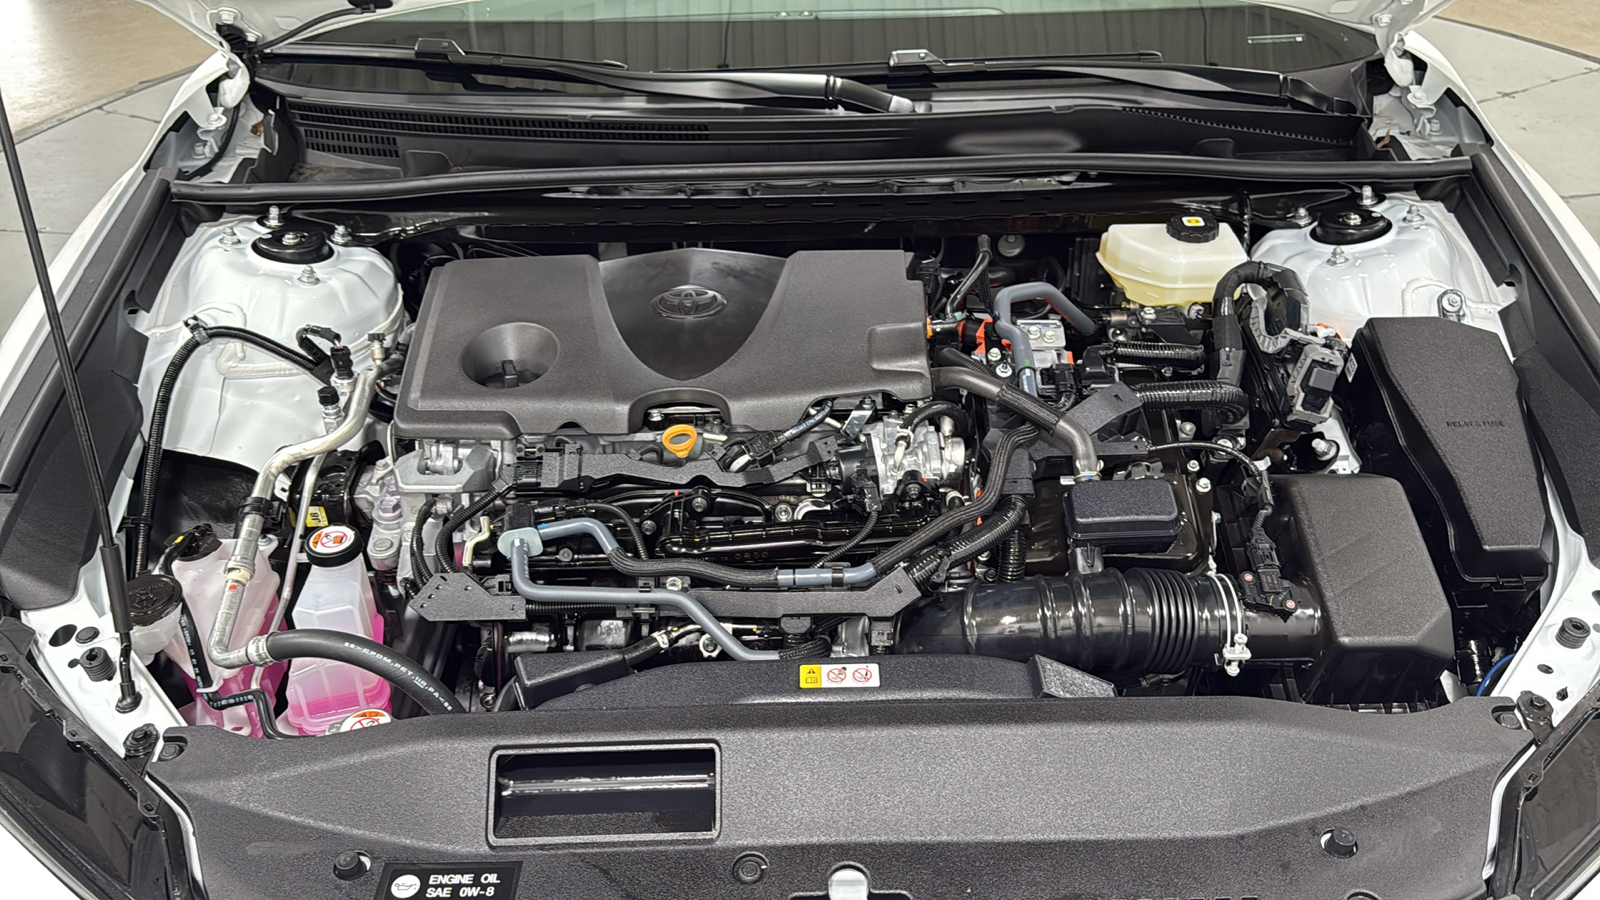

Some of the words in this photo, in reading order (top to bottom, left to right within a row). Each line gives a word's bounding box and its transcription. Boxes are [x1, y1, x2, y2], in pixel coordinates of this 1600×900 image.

[1446, 420, 1473, 428] RELAY
[1482, 420, 1505, 428] FUSE
[428, 873, 475, 885] ENGINE
[480, 873, 501, 884] OIL
[425, 887, 453, 898] SAE
[459, 886, 495, 898] 0W-8
